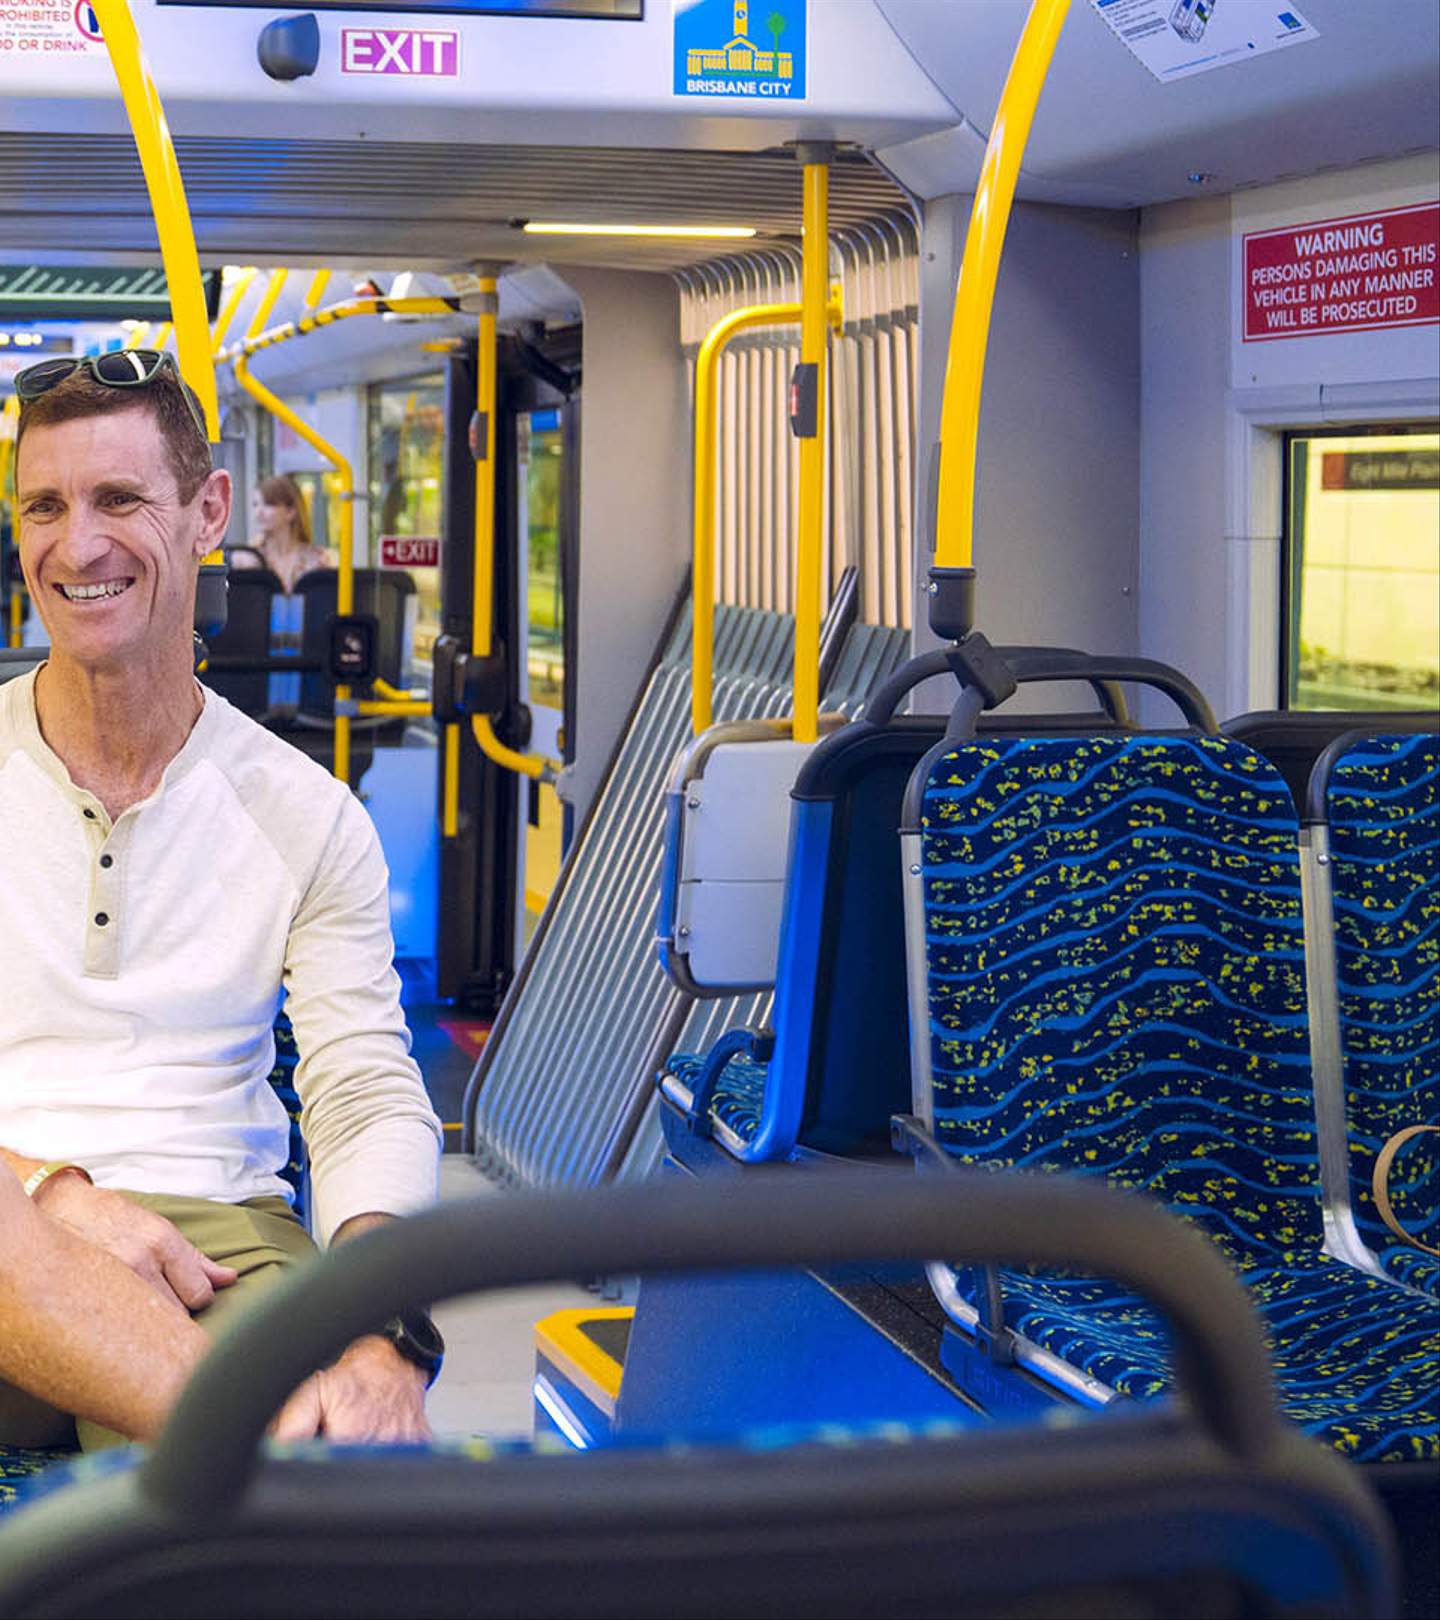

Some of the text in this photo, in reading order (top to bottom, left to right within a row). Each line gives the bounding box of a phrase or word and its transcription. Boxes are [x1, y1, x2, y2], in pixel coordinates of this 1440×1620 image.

[18, 39, 38, 51] OR
[43, 40, 87, 52] DRINK
[345, 31, 455, 73] EXIT
[686, 79, 792, 96] BRISBANE CITY
[1294, 223, 1384, 257] WARNING
[1251, 243, 1436, 286] PERSONS DAMAGING THIS
[1252, 268, 1434, 308] VEHICLE IN ANY MANNER
[1266, 295, 1417, 328] WILL BE PROSECUTED
[396, 541, 435, 562] EXIT
